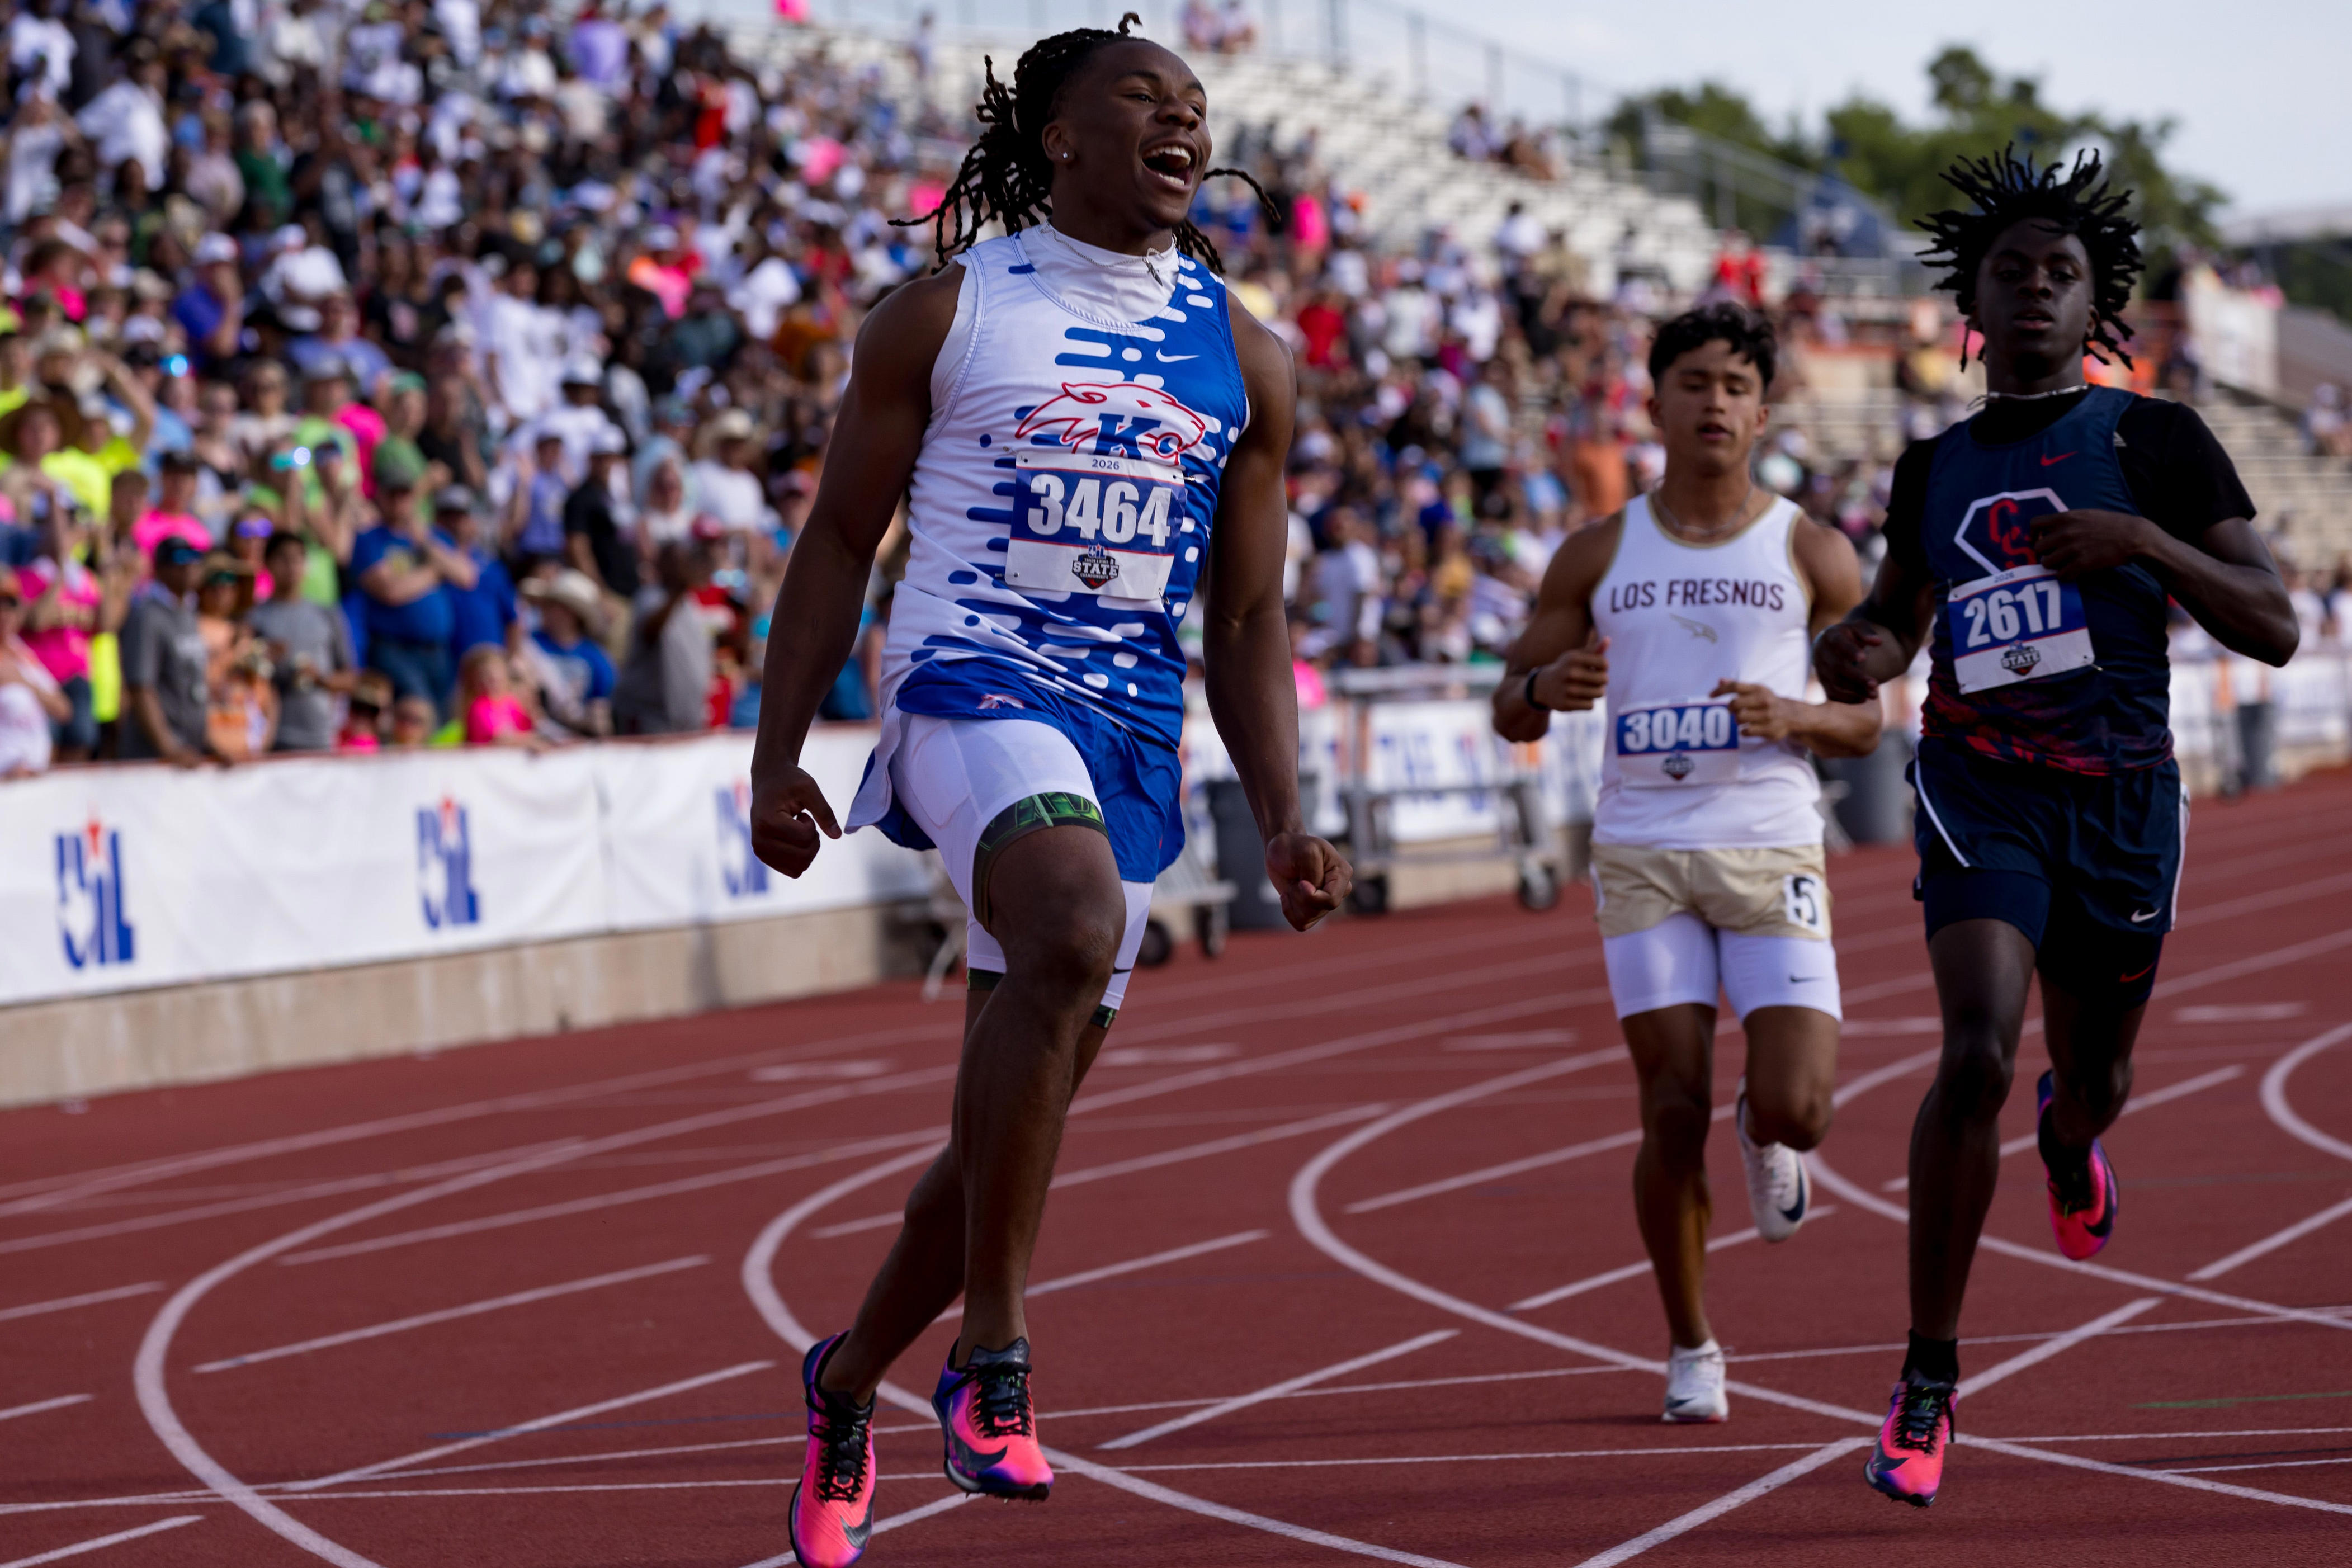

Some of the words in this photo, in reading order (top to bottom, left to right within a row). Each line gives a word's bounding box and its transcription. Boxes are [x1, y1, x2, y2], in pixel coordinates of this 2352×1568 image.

[1092, 458, 1120, 470] 2026
[1027, 474, 1172, 547] 3464
[1073, 561, 1118, 579] STATE
[1611, 581, 1656, 613] LOS
[1666, 578, 1785, 612] FRESNOS
[1964, 579, 2062, 649] 2617
[1624, 705, 1731, 752] 3040
[1792, 875, 1818, 925] 5
